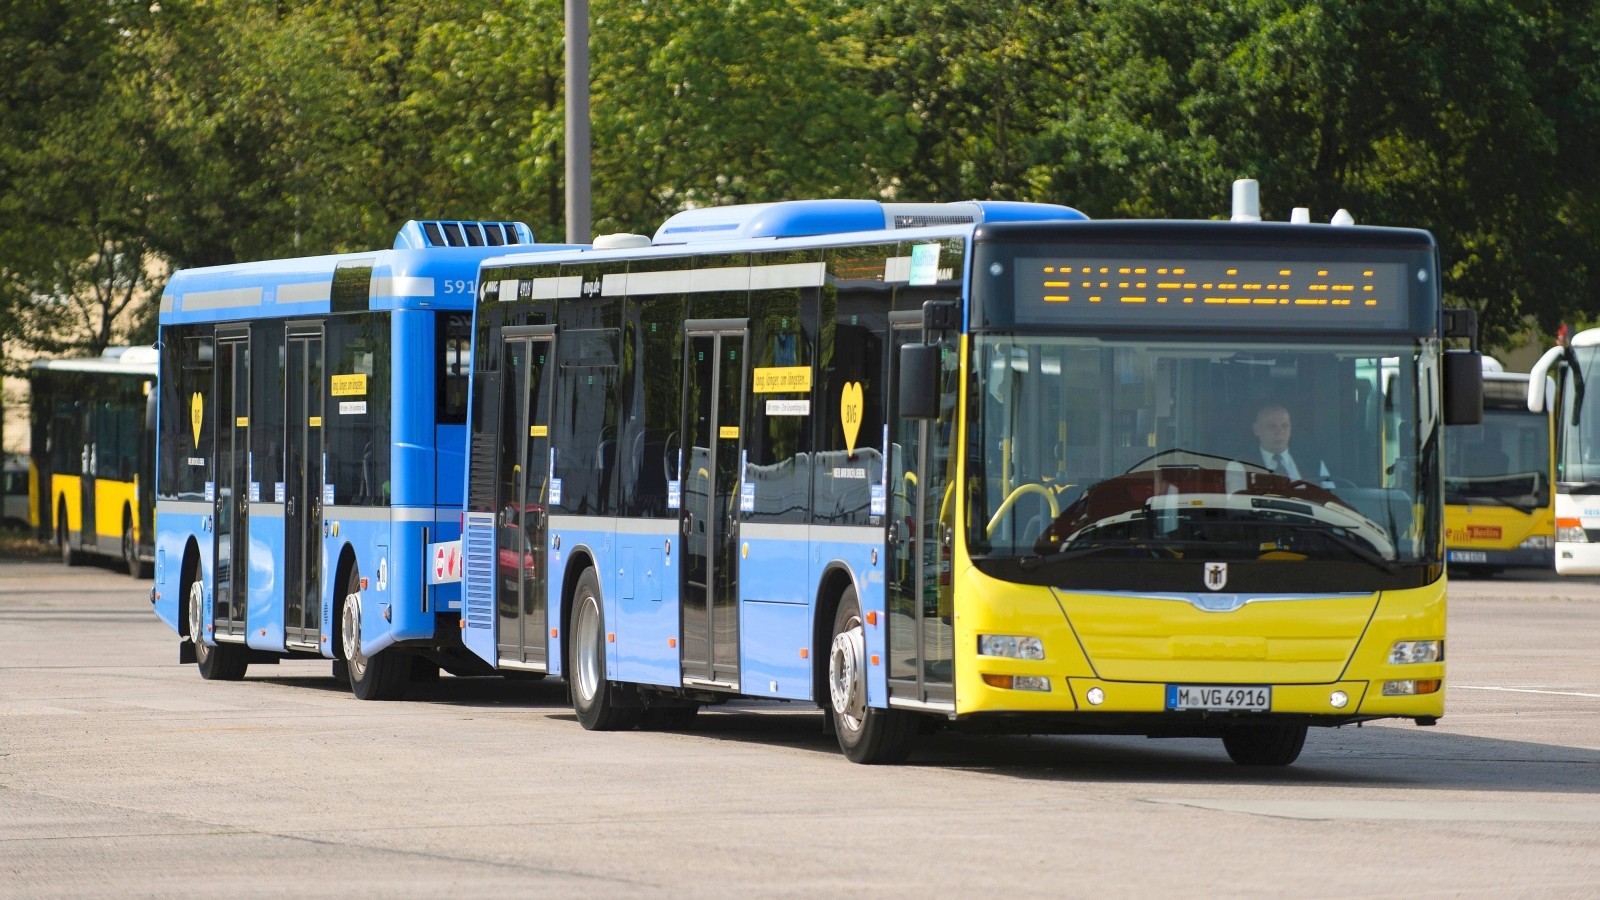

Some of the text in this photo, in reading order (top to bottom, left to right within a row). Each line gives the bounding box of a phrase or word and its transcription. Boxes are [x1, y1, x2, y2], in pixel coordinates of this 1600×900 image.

[937, 268, 953, 280] MAN
[846, 404, 857, 423] BVG
[1473, 527, 1499, 537] Berlin
[1179, 689, 1190, 705] M
